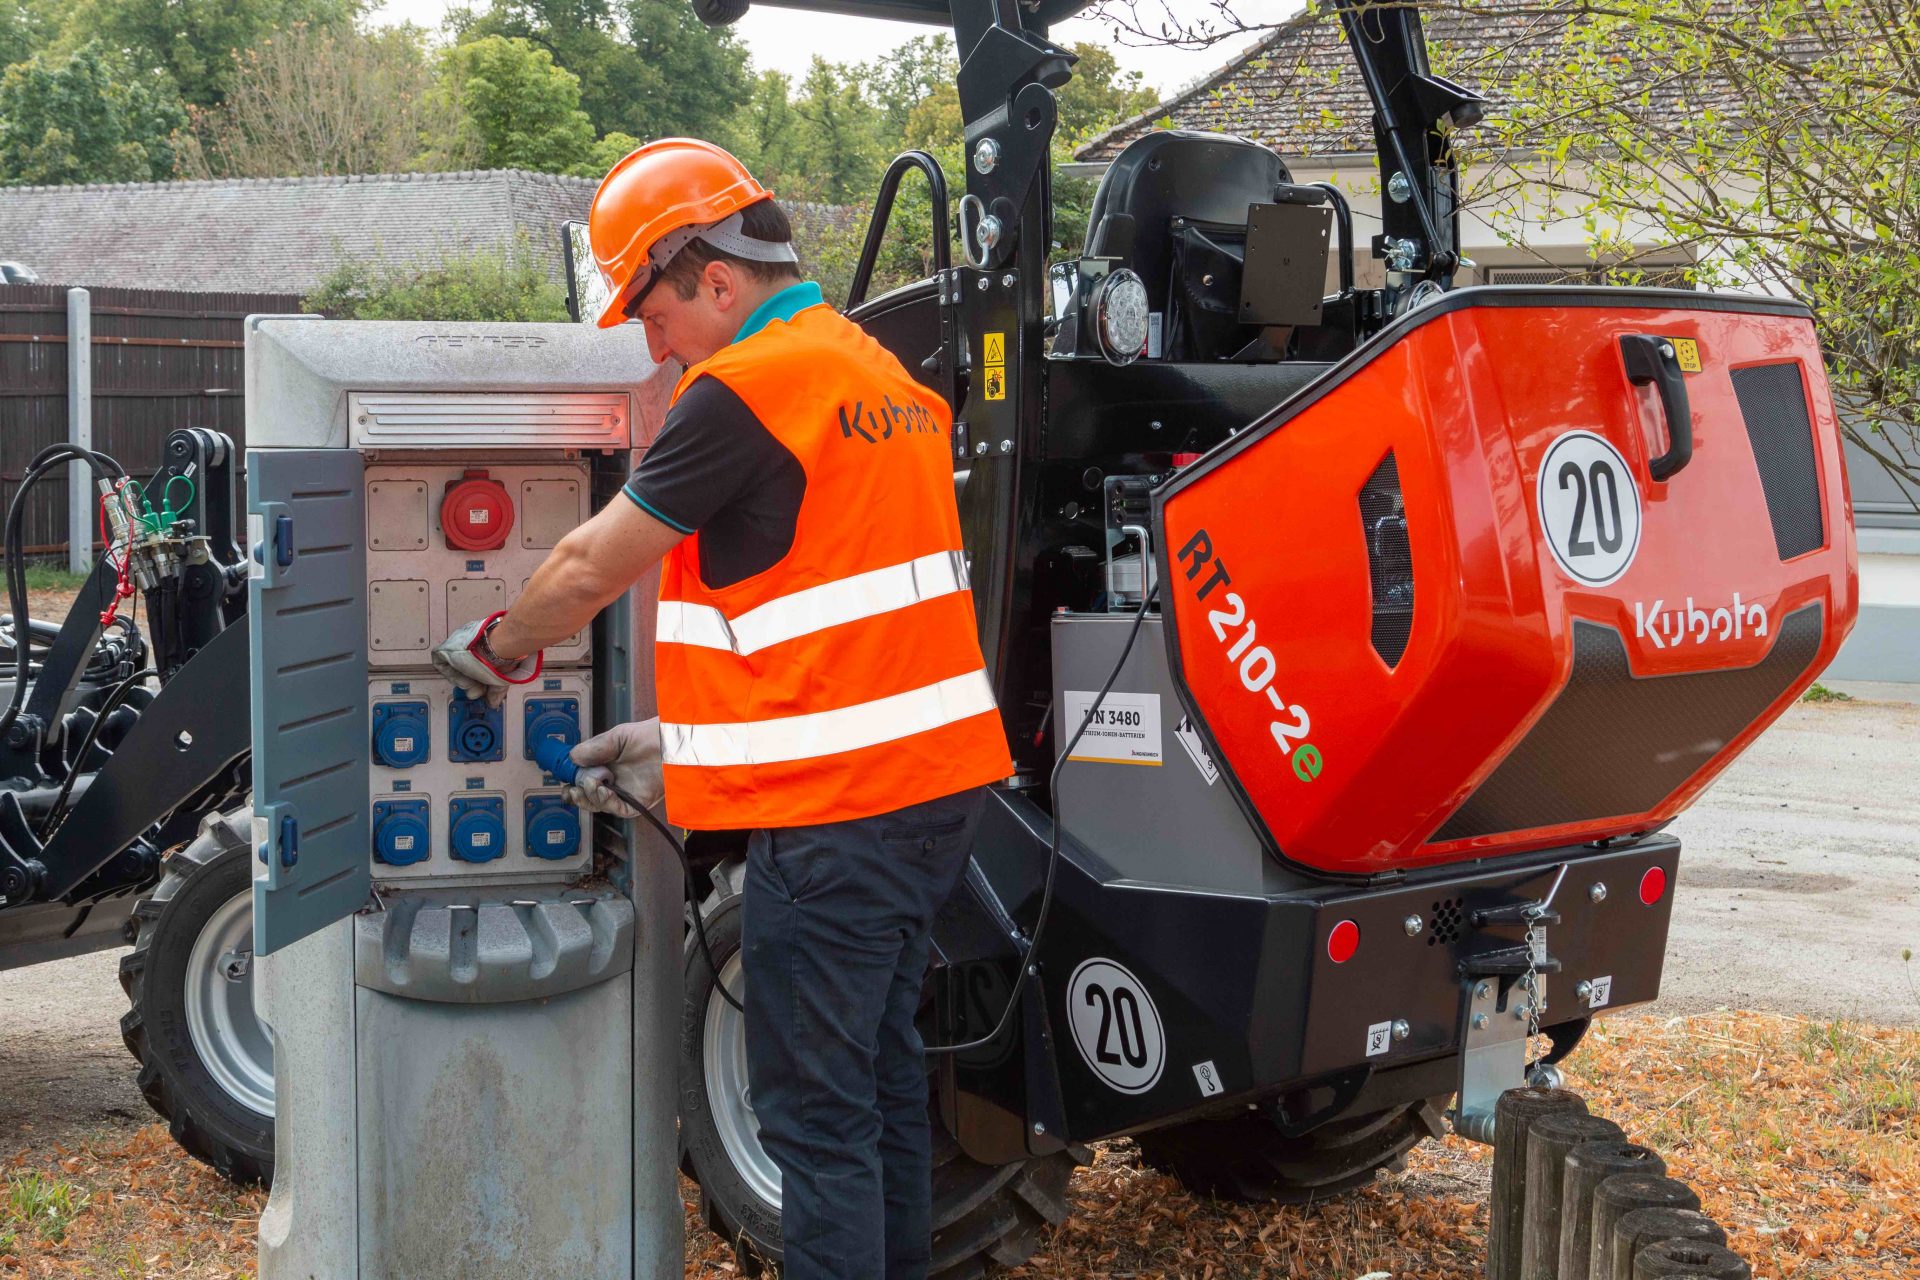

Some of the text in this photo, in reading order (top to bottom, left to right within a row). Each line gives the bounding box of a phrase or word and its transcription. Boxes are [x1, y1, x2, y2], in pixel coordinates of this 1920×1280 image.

[1558, 459, 1623, 557] 20
[1634, 592, 1768, 649] Kubota
[1082, 730, 1145, 739] ITHIUM-IONEN-BATTERIEN
[1108, 710, 1140, 726] 3480
[1085, 982, 1148, 1068] 20
